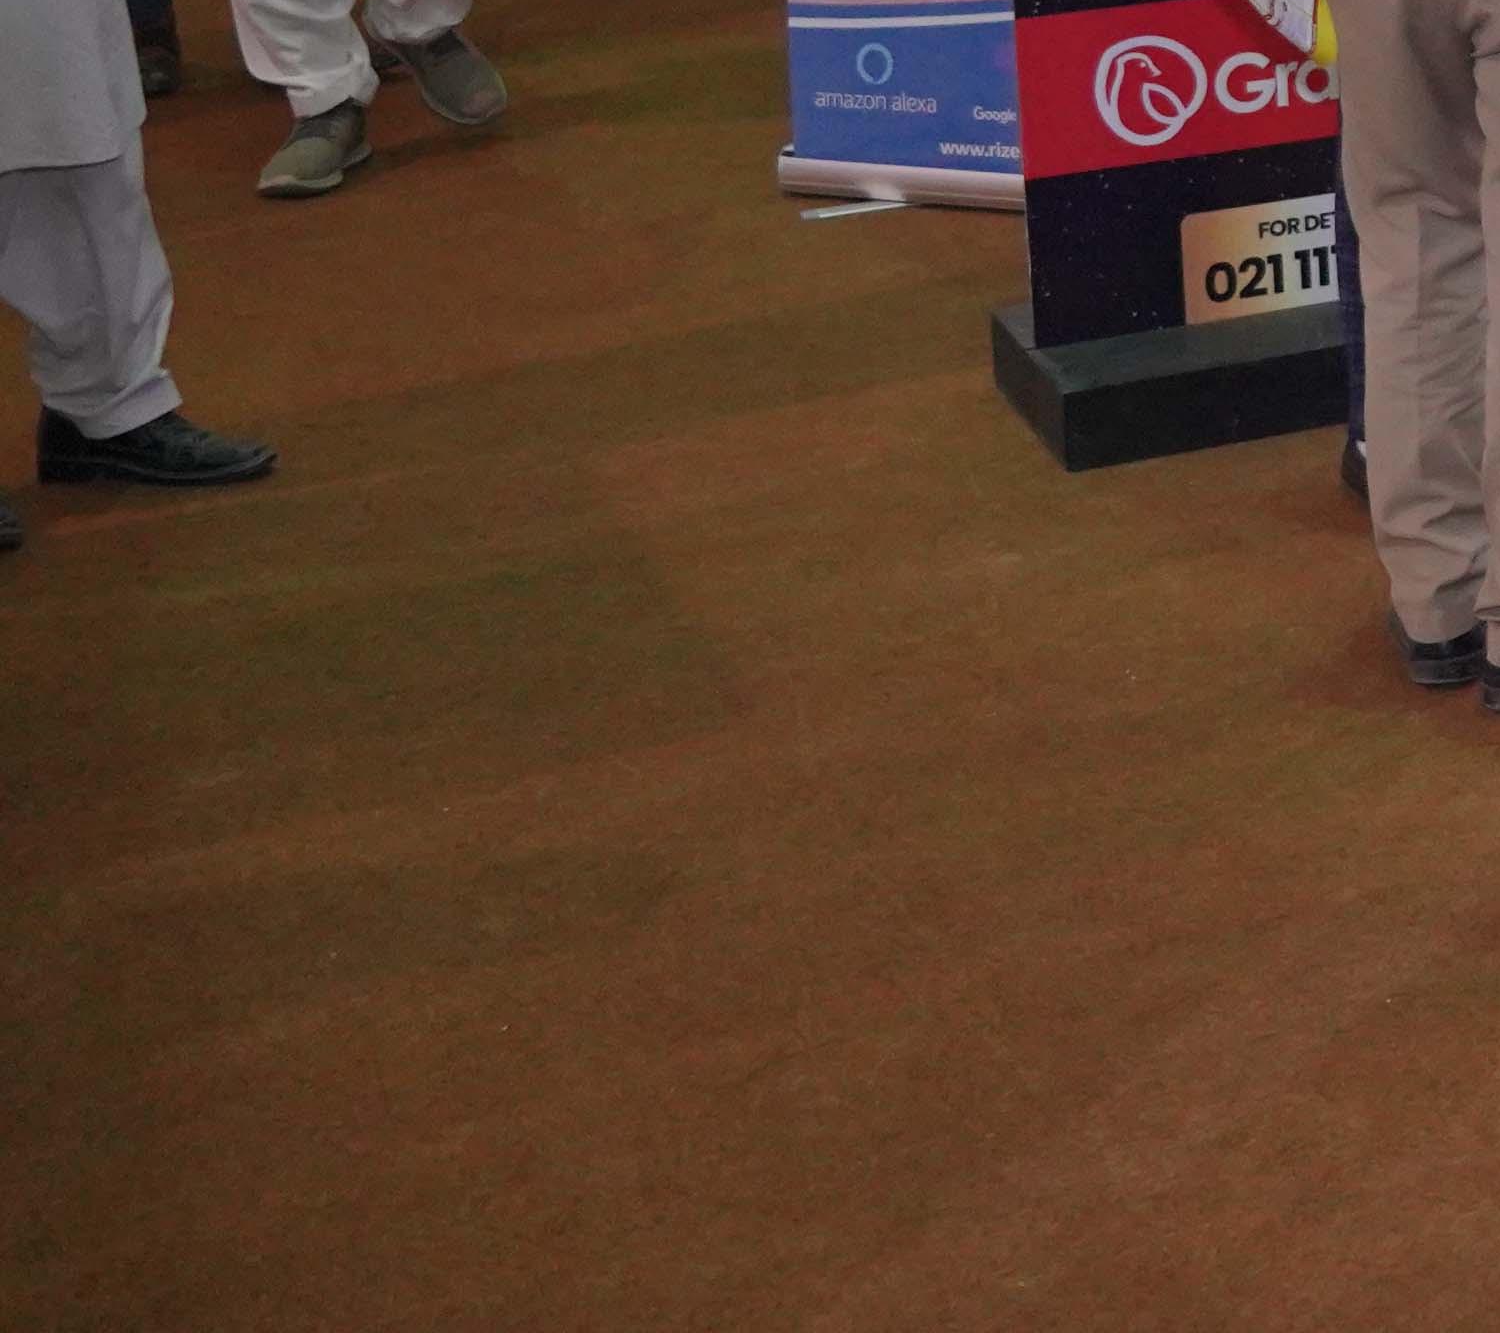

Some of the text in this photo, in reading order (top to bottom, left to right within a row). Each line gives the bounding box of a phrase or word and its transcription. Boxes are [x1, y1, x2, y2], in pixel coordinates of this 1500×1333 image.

[814, 91, 937, 113] amazon alexa
[1258, 217, 1302, 239] FOR
[1205, 253, 1285, 304] 021
